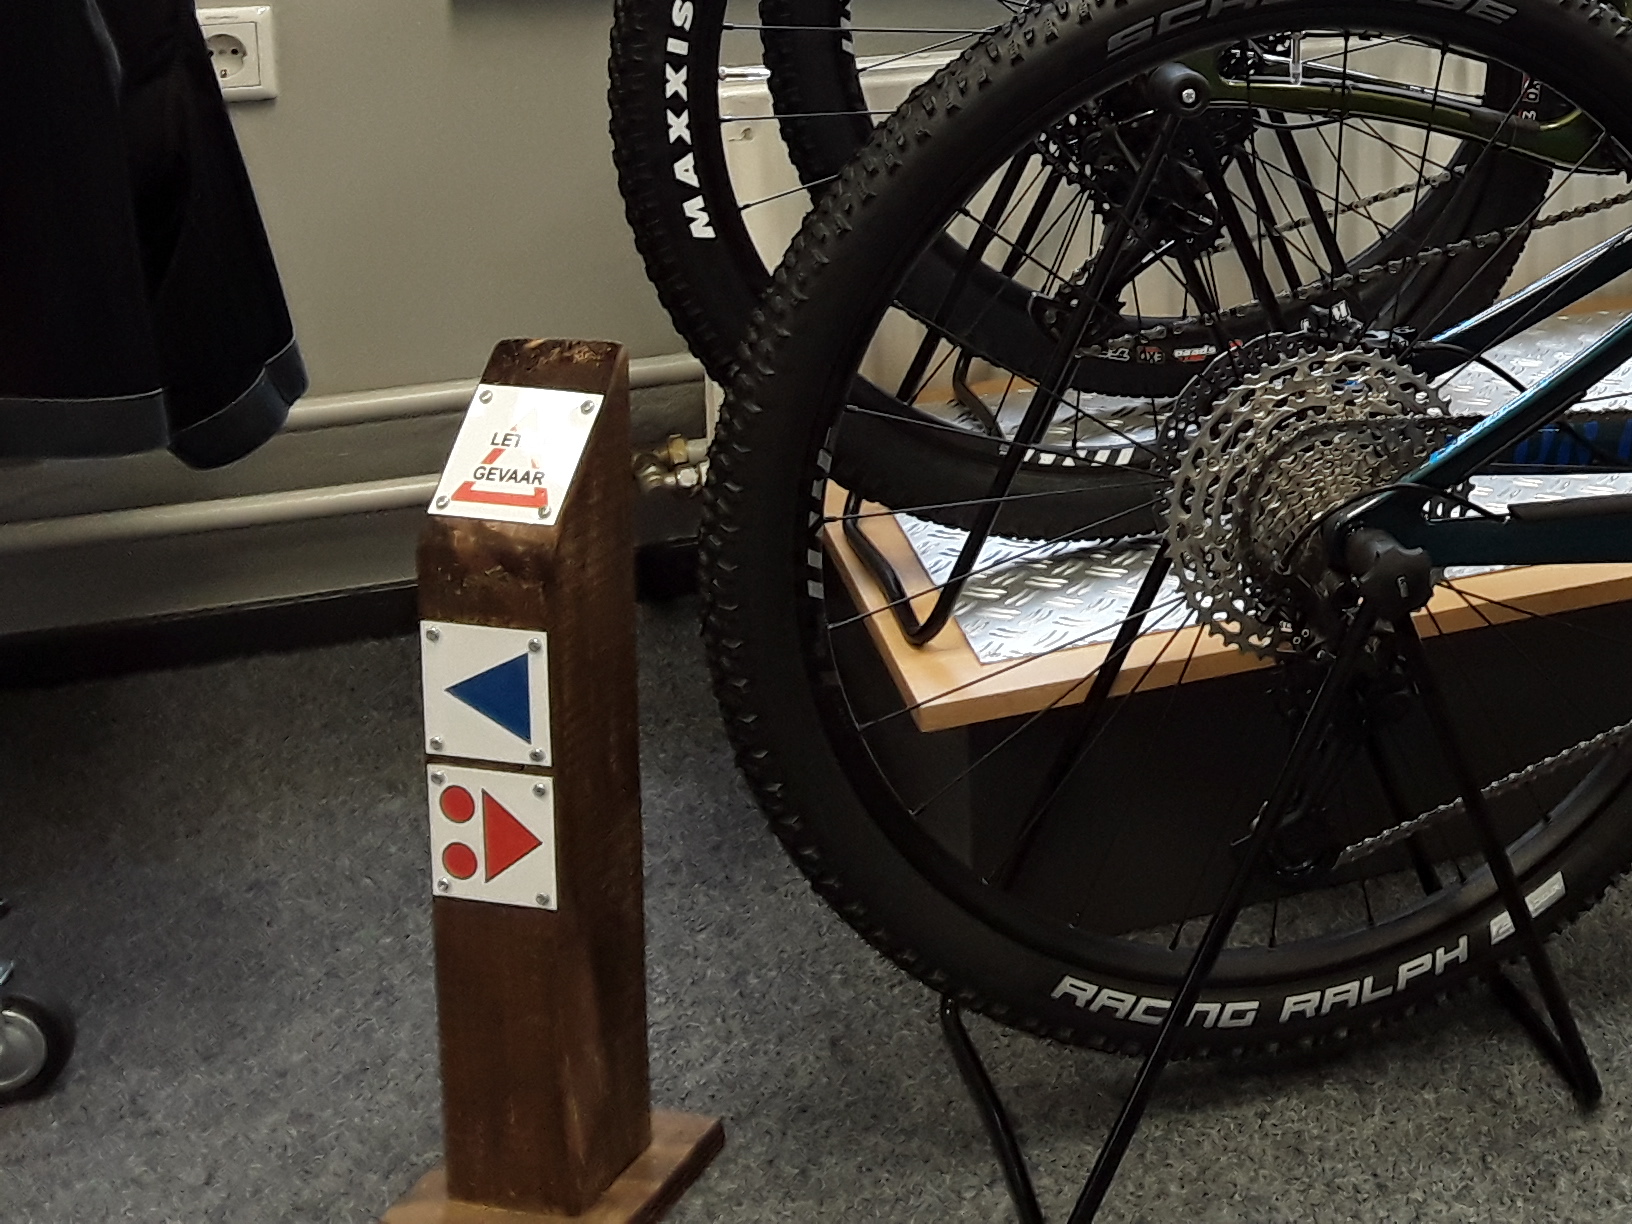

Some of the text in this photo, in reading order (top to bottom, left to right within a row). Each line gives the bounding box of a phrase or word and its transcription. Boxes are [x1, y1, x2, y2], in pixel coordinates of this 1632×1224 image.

[472, 465, 546, 486] GEVAAR
[1050, 934, 1470, 1029] RACNG RALPH
